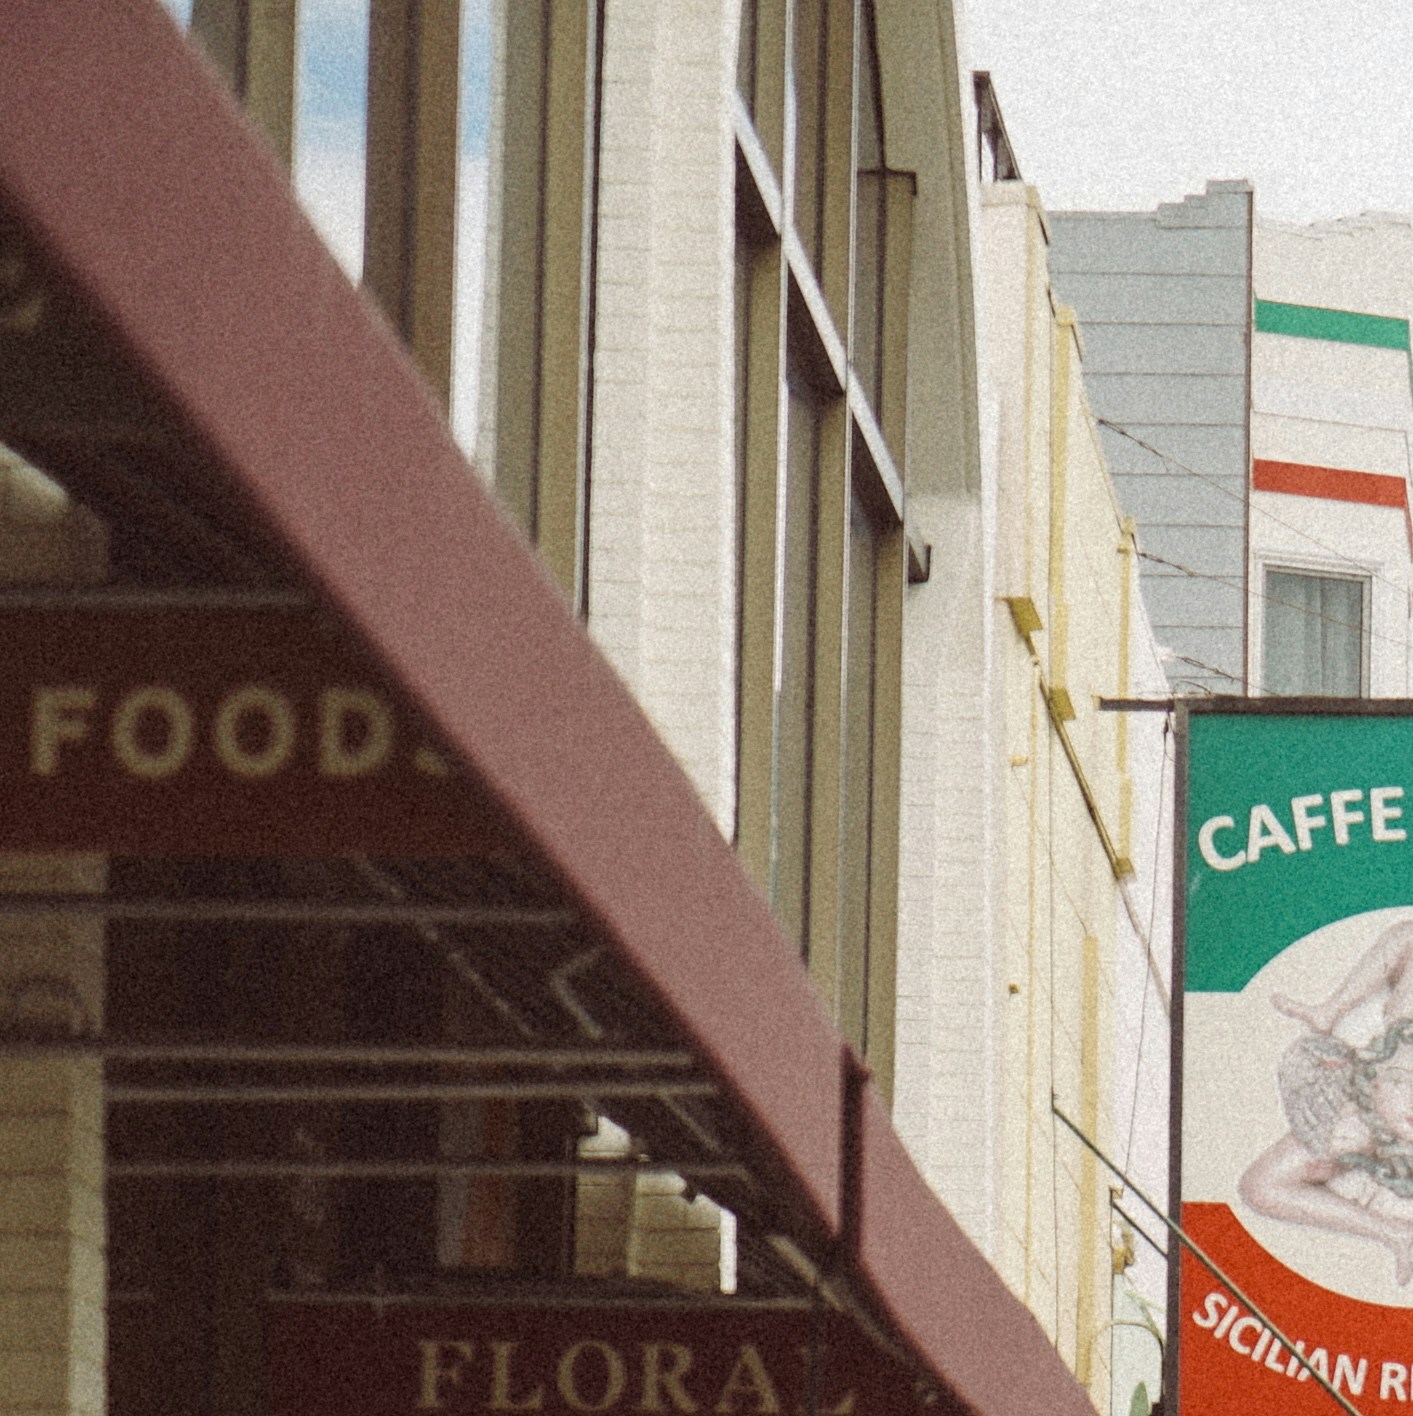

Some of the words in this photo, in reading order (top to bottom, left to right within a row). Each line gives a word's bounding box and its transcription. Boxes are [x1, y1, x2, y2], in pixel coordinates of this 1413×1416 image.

[1197, 785, 1408, 873] CAFFE
[414, 1338, 856, 1416] FLORAL
[1191, 1291, 1367, 1397] SICILIAN
